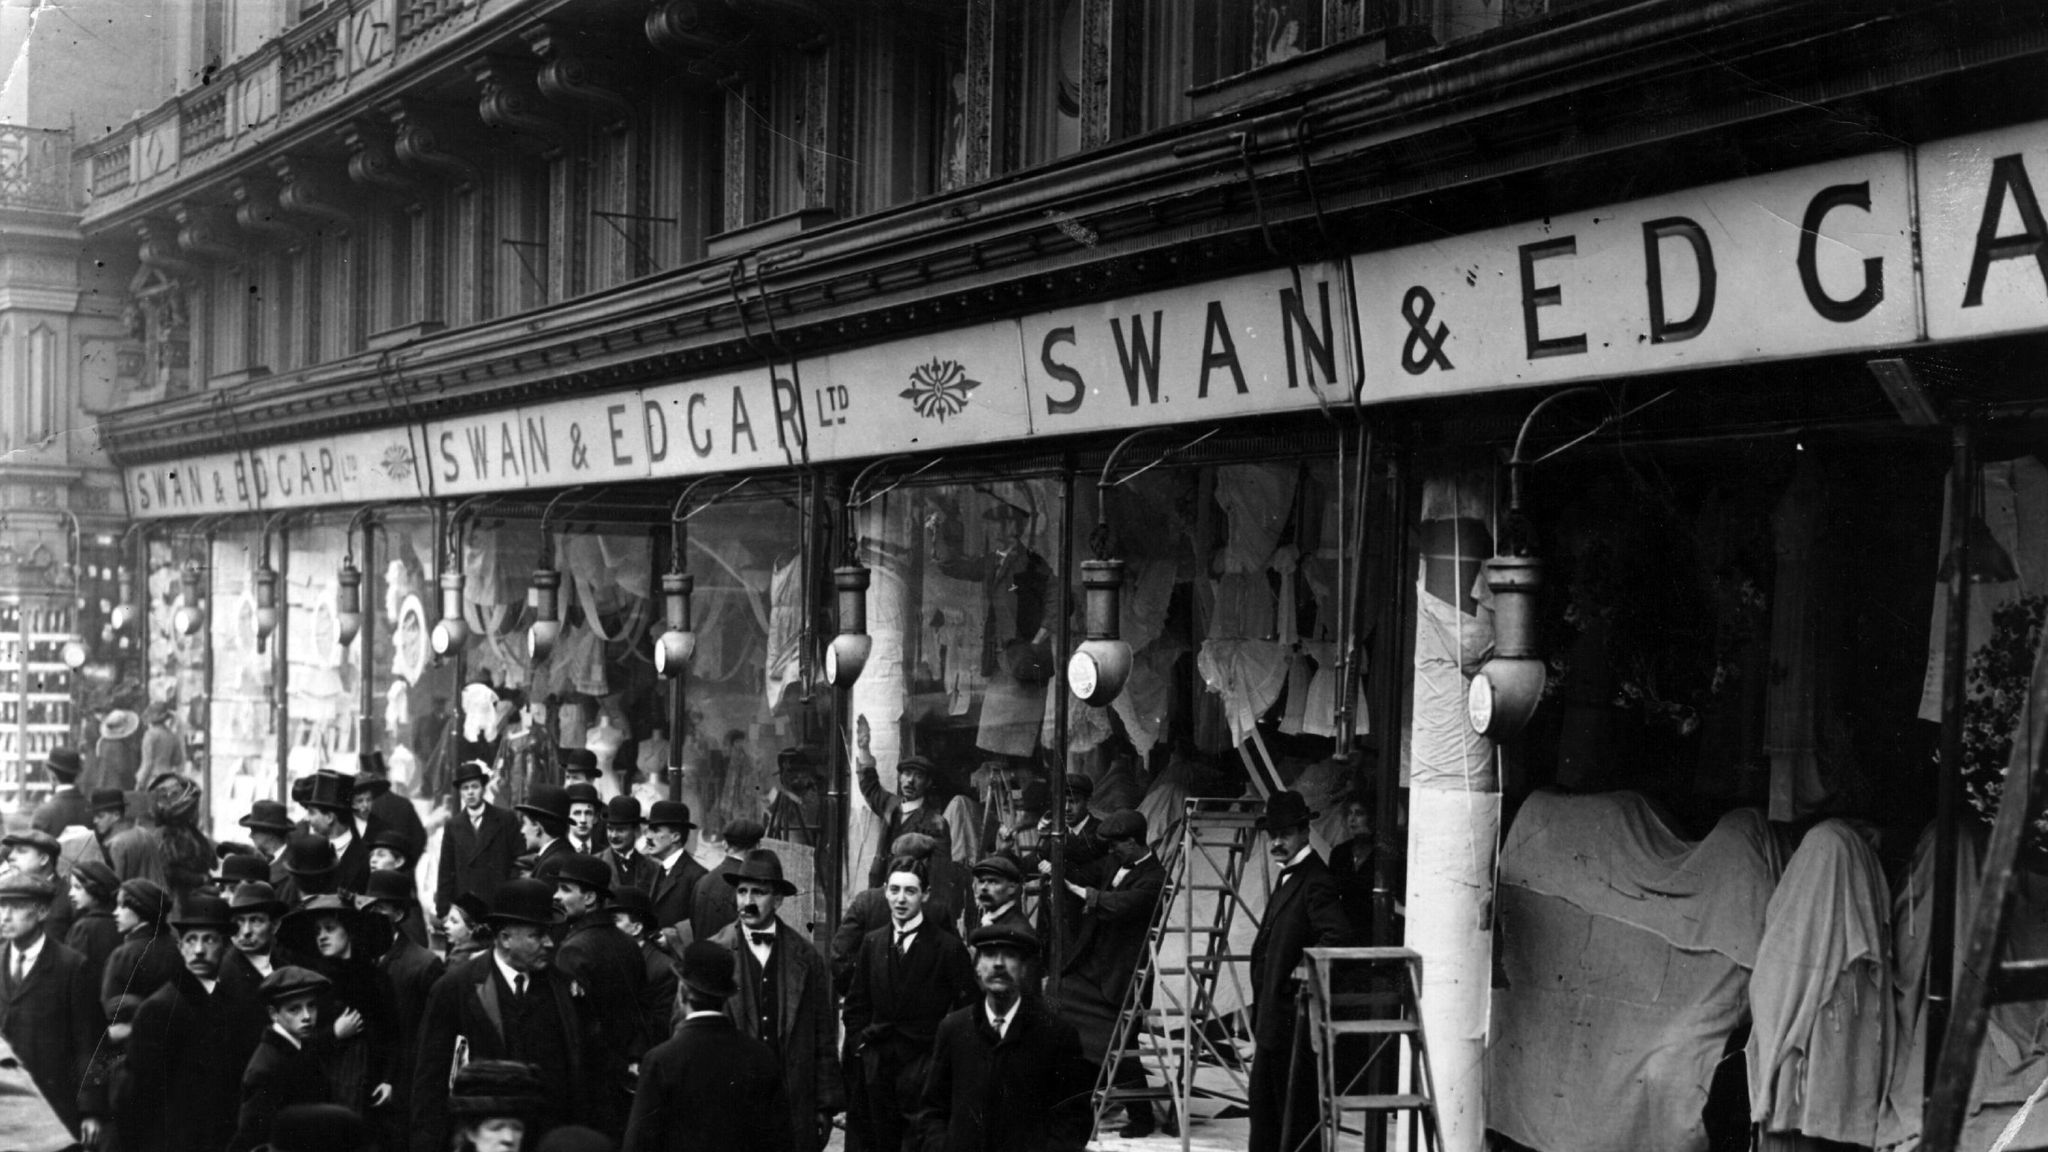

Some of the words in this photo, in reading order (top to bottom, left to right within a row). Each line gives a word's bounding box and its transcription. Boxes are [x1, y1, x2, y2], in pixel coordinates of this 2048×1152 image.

[1041, 281, 1337, 415] SWAN
[1401, 285, 1455, 375] &
[137, 466, 203, 509] SWAN
[213, 470, 228, 505] &
[234, 447, 337, 500] EDGAR
[440, 416, 550, 482] SWAN
[570, 422, 590, 470] &
[607, 378, 802, 466] EDGAR
